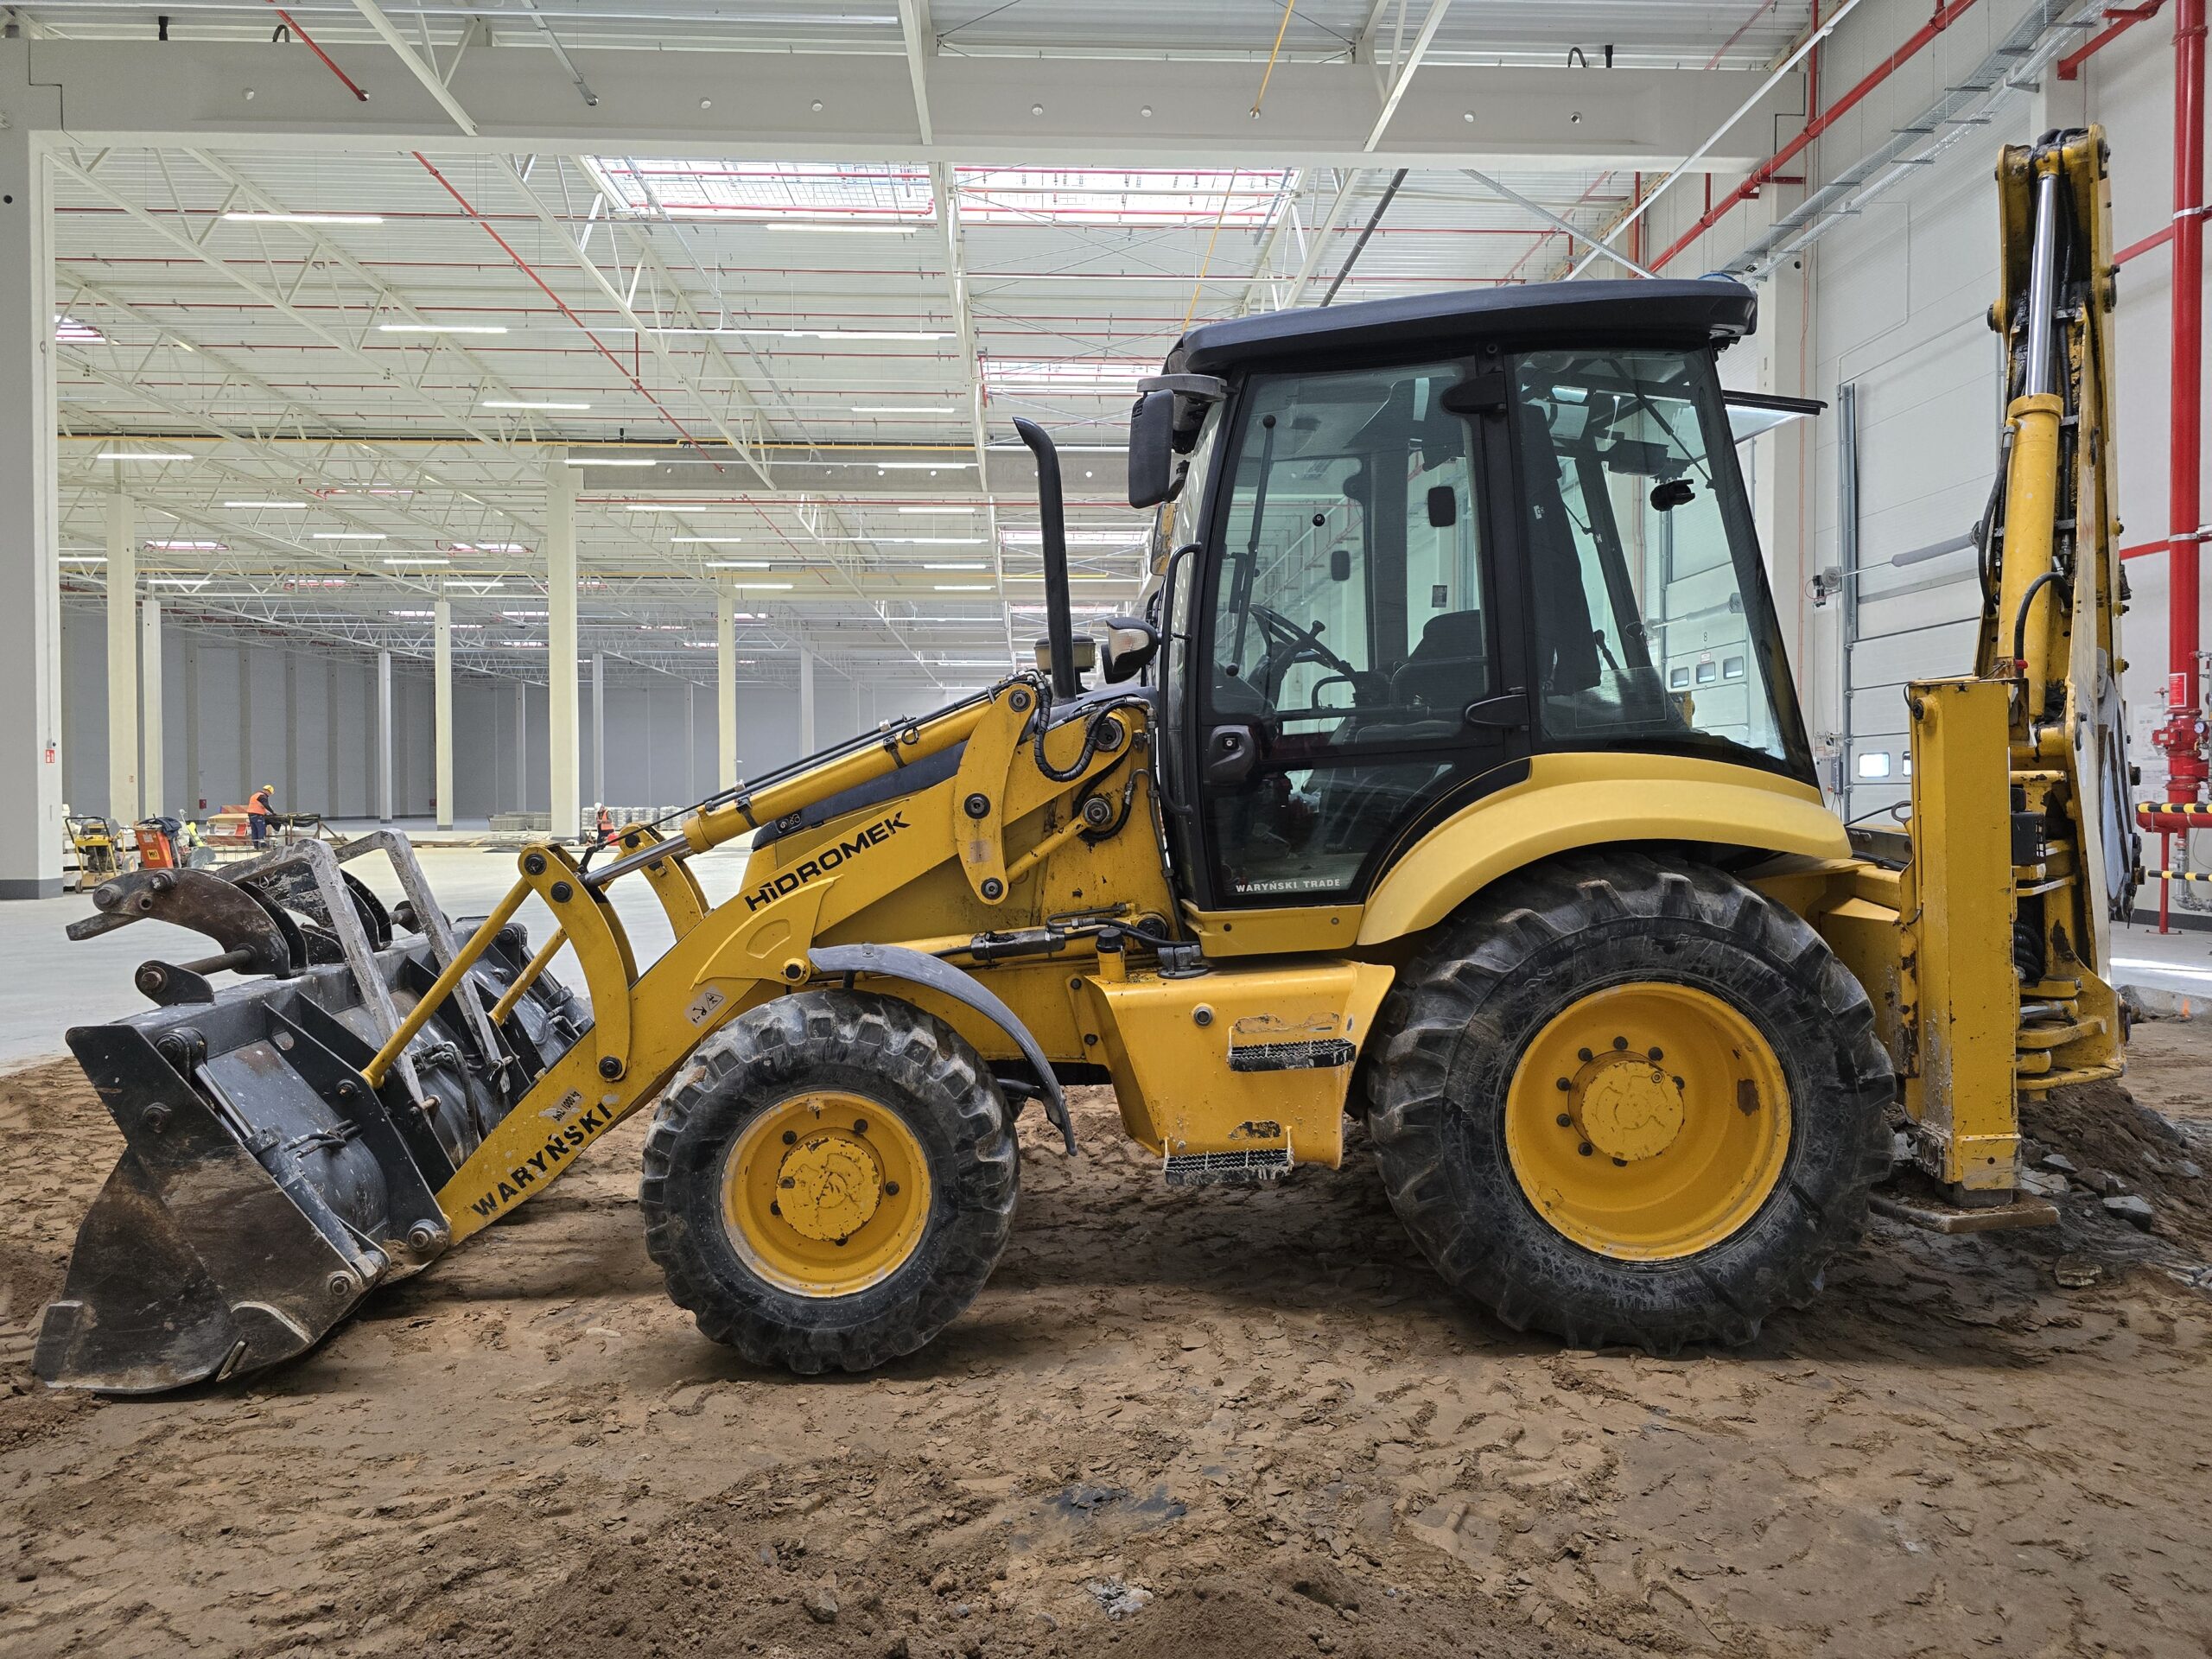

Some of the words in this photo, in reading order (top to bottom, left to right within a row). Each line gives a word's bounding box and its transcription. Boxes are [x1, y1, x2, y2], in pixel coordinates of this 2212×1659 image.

[1236, 880, 1298, 893] WARYŃSKI
[1303, 878, 1340, 888] TRADE
[561, 1096, 575, 1110] 1000
[470, 1102, 613, 1217] WARYŃSKI
